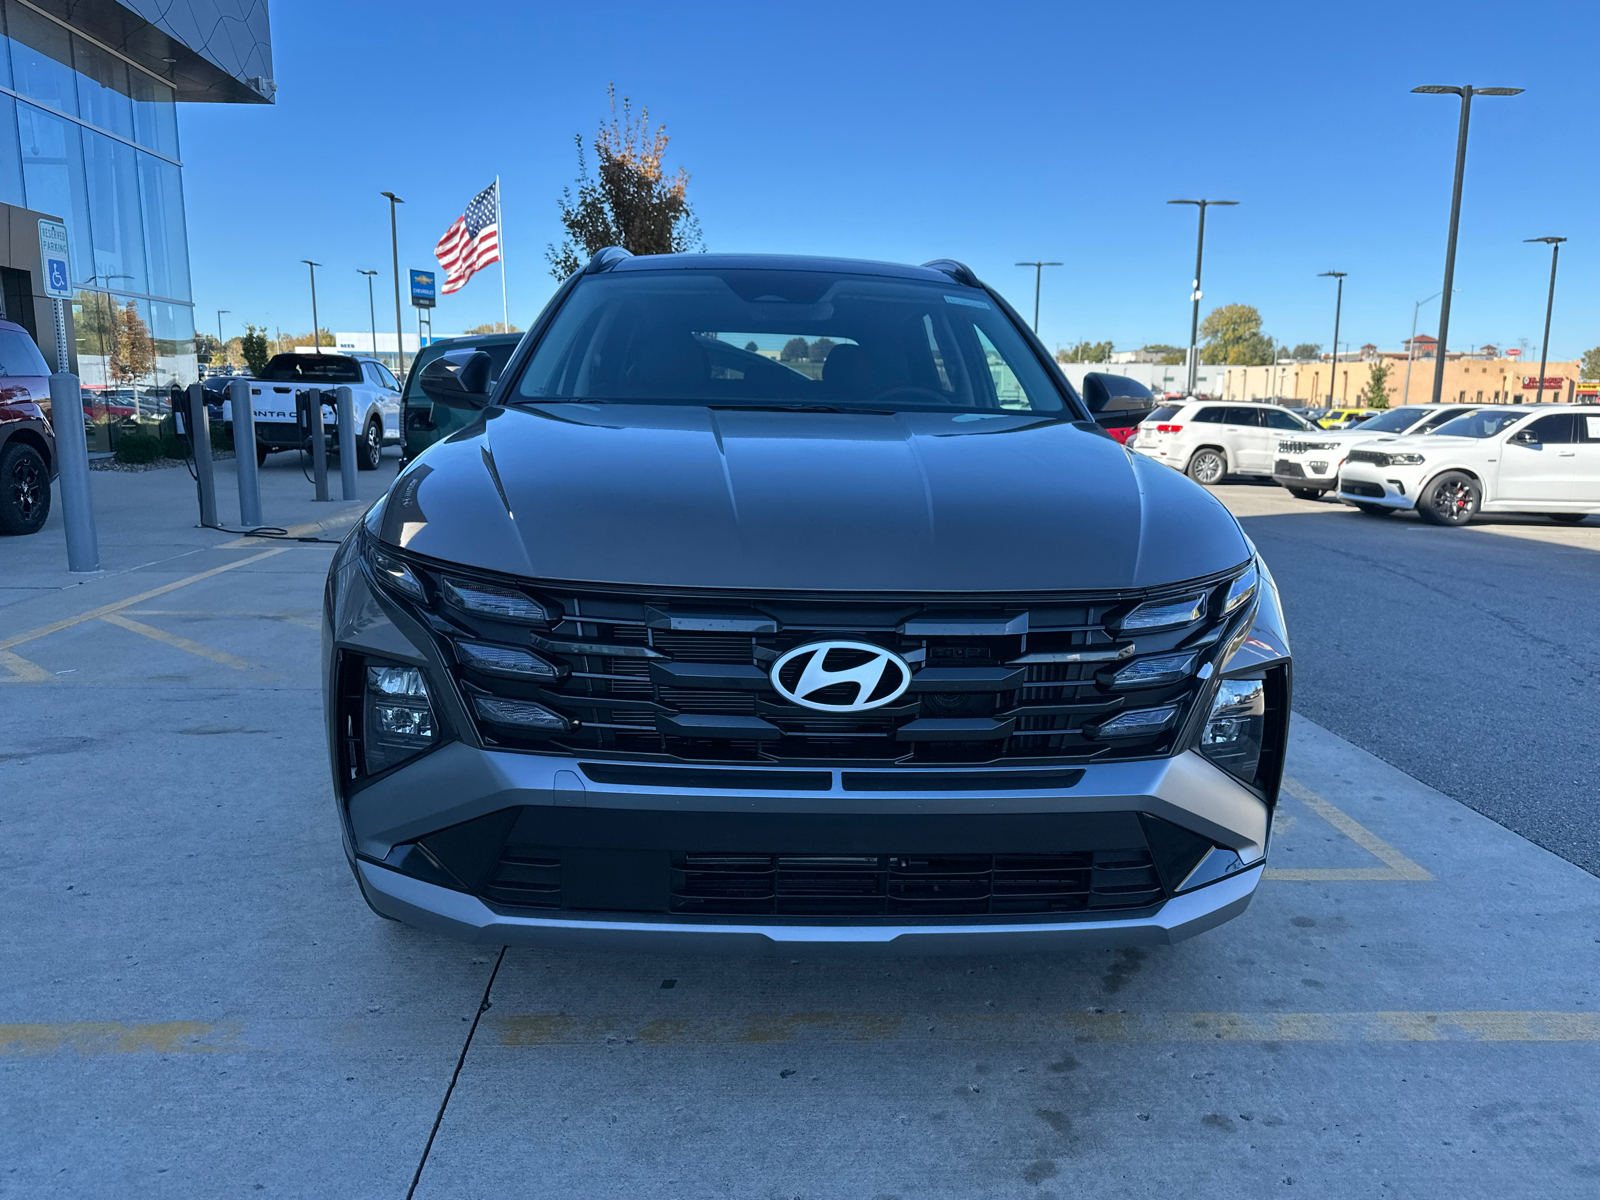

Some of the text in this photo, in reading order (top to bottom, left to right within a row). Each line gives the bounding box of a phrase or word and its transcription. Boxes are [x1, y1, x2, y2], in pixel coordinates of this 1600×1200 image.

[41, 228, 65, 241] RESERVED
[43, 241, 67, 254] PARKING
[413, 288, 435, 296] CHEVROLET
[253, 410, 286, 418] ANTA
